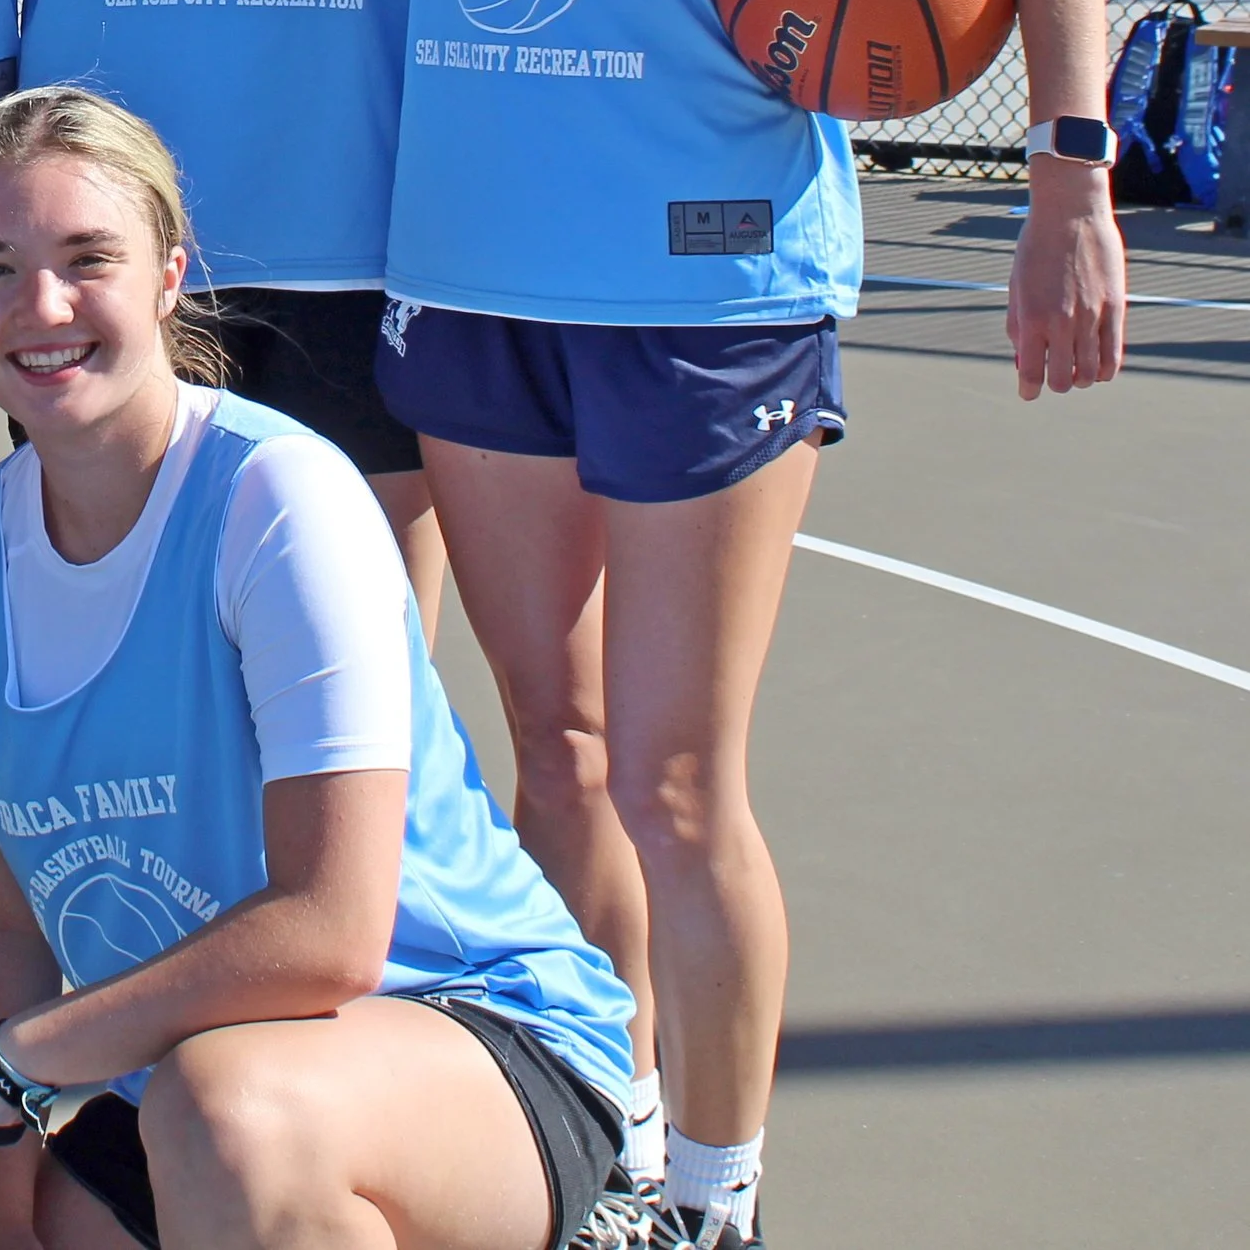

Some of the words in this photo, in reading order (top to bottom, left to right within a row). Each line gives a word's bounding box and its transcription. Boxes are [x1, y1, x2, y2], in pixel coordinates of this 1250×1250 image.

[416, 39, 439, 66] SEA
[443, 41, 470, 68] ISLE
[471, 45, 509, 72] CITY
[515, 46, 645, 79] RECREATION
[697, 211, 710, 225] M
[729, 230, 767, 240] AUGUSTA
[75, 775, 177, 822] FAMILY
[30, 834, 131, 899] BASKETBALL
[140, 848, 221, 922] TOURNA
